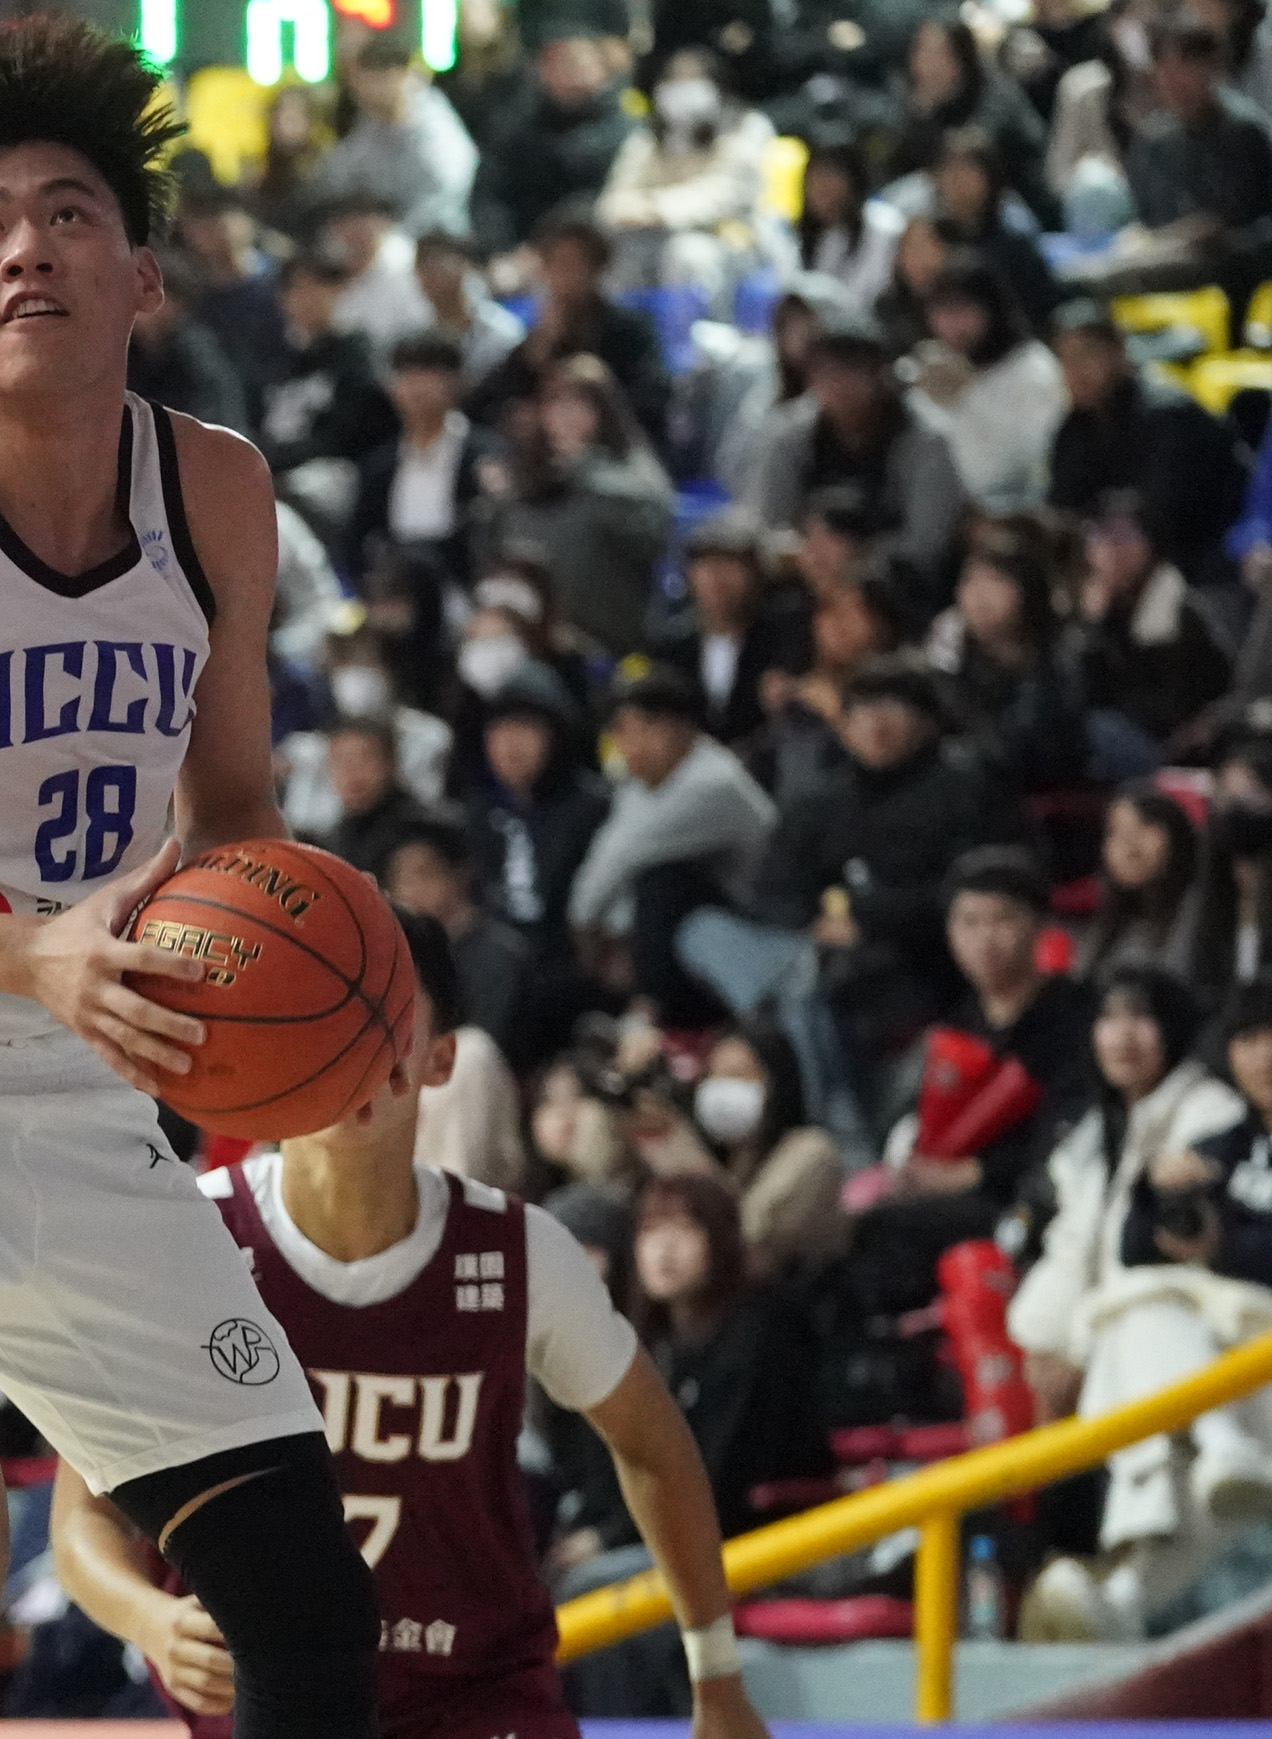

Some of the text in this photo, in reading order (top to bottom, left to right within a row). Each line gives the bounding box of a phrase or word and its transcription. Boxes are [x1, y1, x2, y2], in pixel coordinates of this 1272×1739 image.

[34, 764, 137, 882] 28
[198, 852, 322, 920] LDING
[138, 919, 264, 972] EGACY
[305, 1367, 485, 1463] JCU
[340, 1493, 402, 1571] 7
[379, 1617, 457, 1657] 金會
